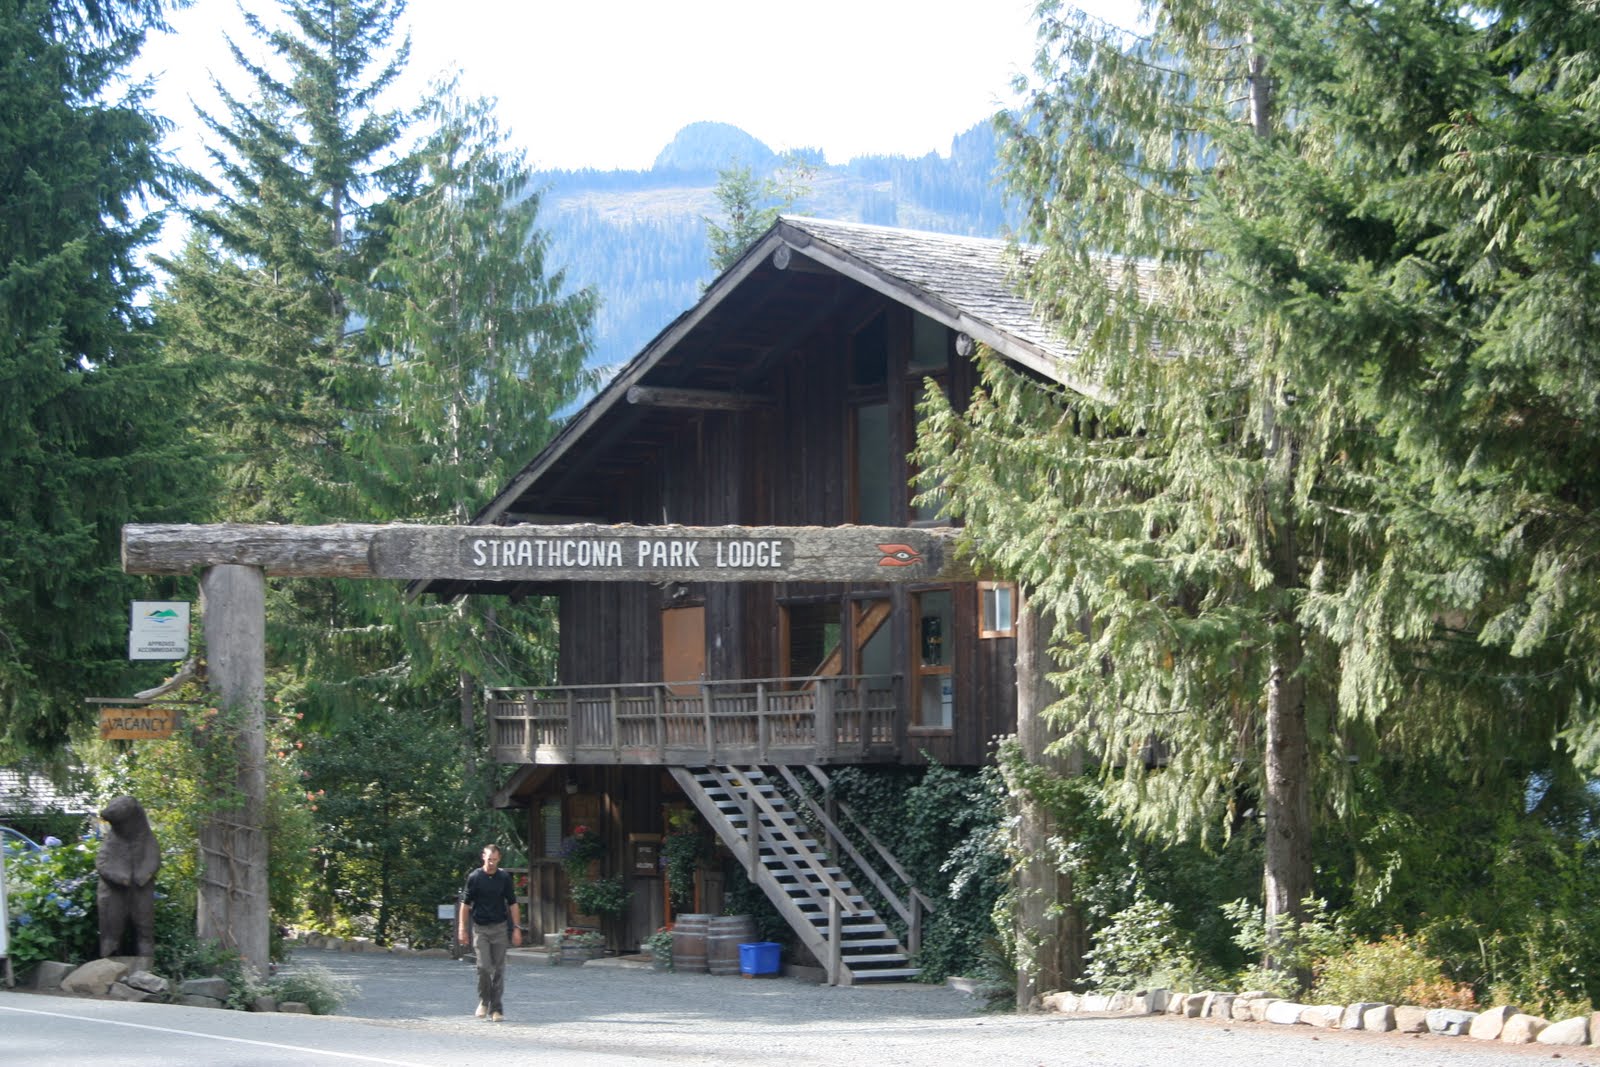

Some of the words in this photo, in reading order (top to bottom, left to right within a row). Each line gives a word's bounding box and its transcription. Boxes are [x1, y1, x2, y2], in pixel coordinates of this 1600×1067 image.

[473, 540, 623, 567] STRATHCONA
[637, 540, 700, 567] PARK
[716, 540, 782, 567] LODGE
[108, 717, 168, 732] VACANCY
